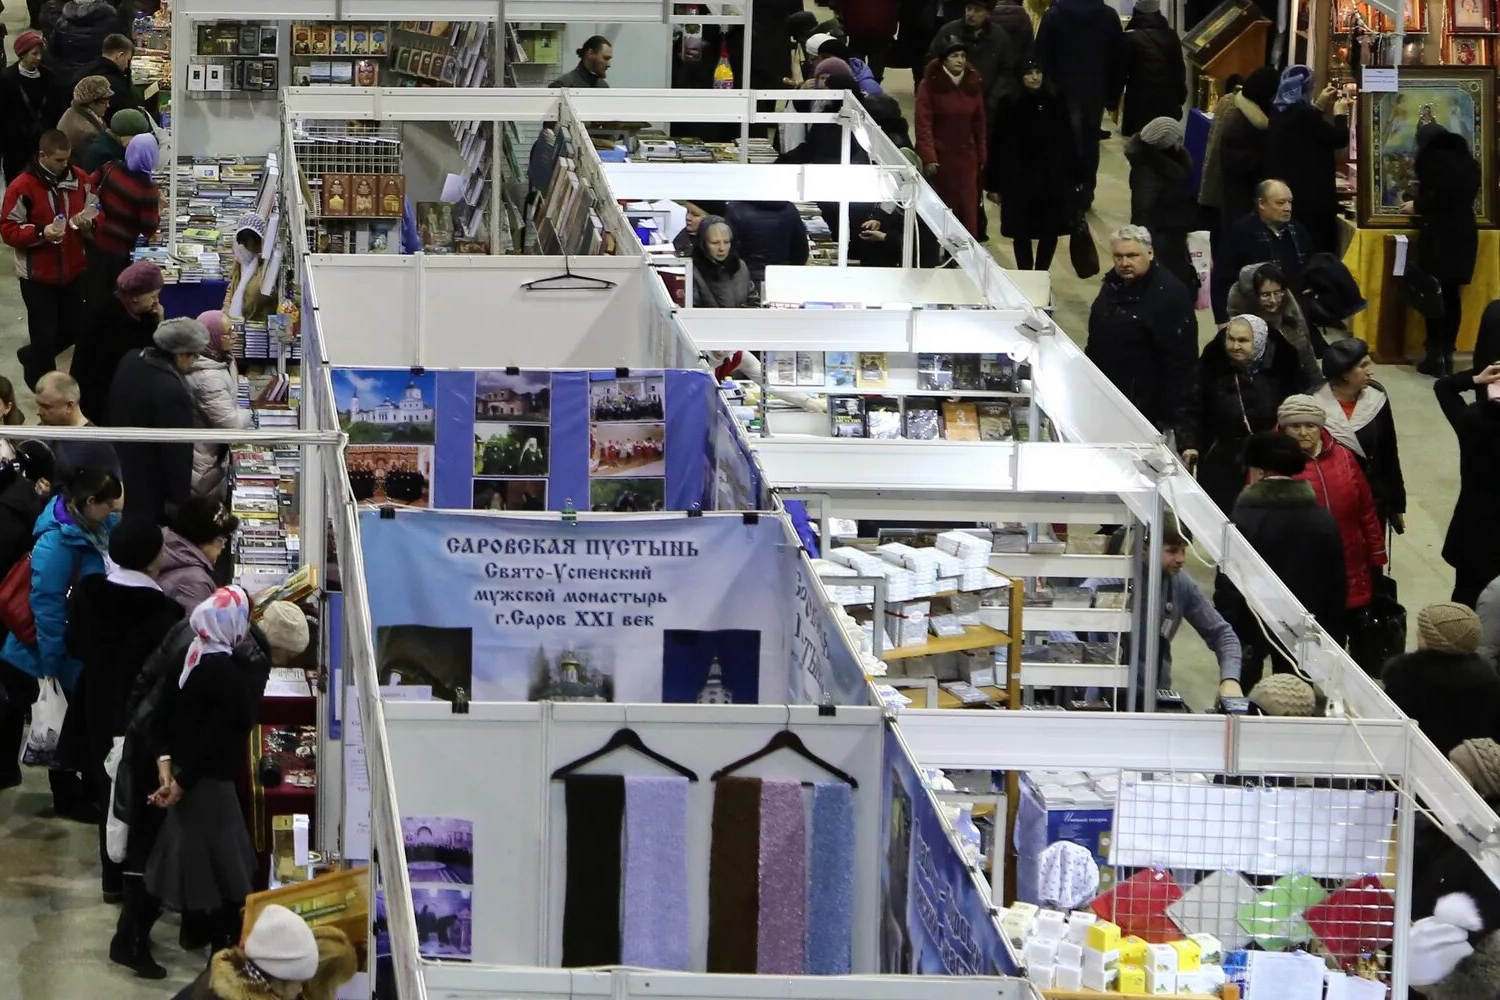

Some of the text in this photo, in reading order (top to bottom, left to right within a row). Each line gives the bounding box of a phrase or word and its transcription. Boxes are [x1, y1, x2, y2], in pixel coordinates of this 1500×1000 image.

[446, 537, 700, 560] САРОВСКАЯ ПУСТЫНЬ
[483, 562, 653, 584] Свято-Успенский
[474, 588, 668, 607] мужской монастырь
[494, 611, 655, 630] г.Саров XXI век
